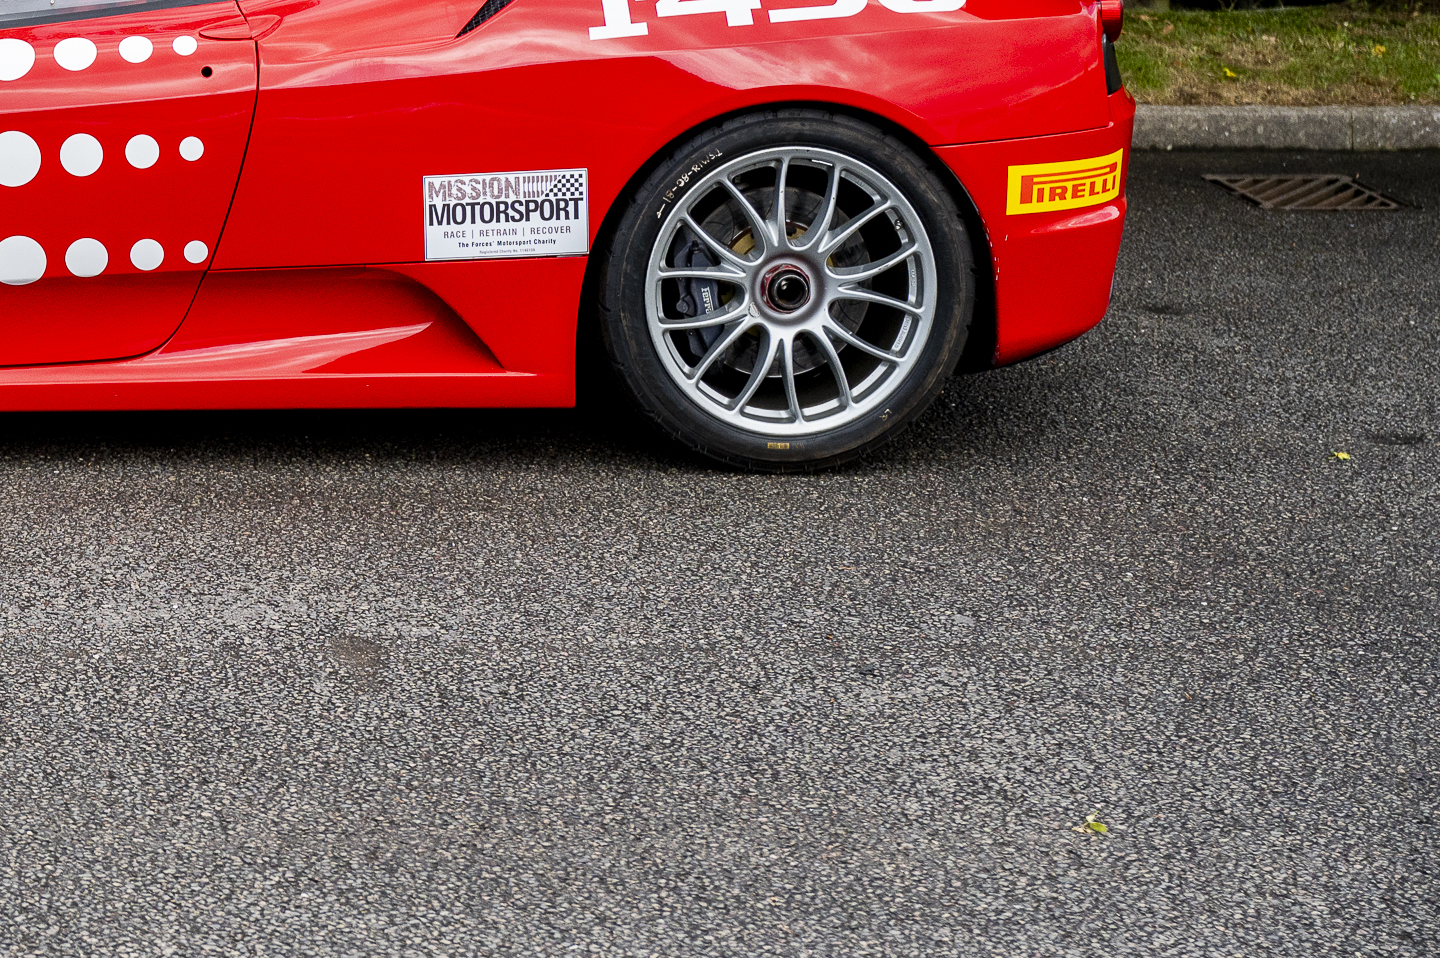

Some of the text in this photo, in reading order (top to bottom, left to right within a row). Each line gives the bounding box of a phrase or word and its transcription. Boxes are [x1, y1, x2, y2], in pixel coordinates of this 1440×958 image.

[428, 176, 521, 202] MISSION
[1020, 161, 1118, 204] PIRELLI
[429, 197, 584, 226] MOTORSPORT
[443, 226, 571, 239] RACE RETRAIN RECOVER
